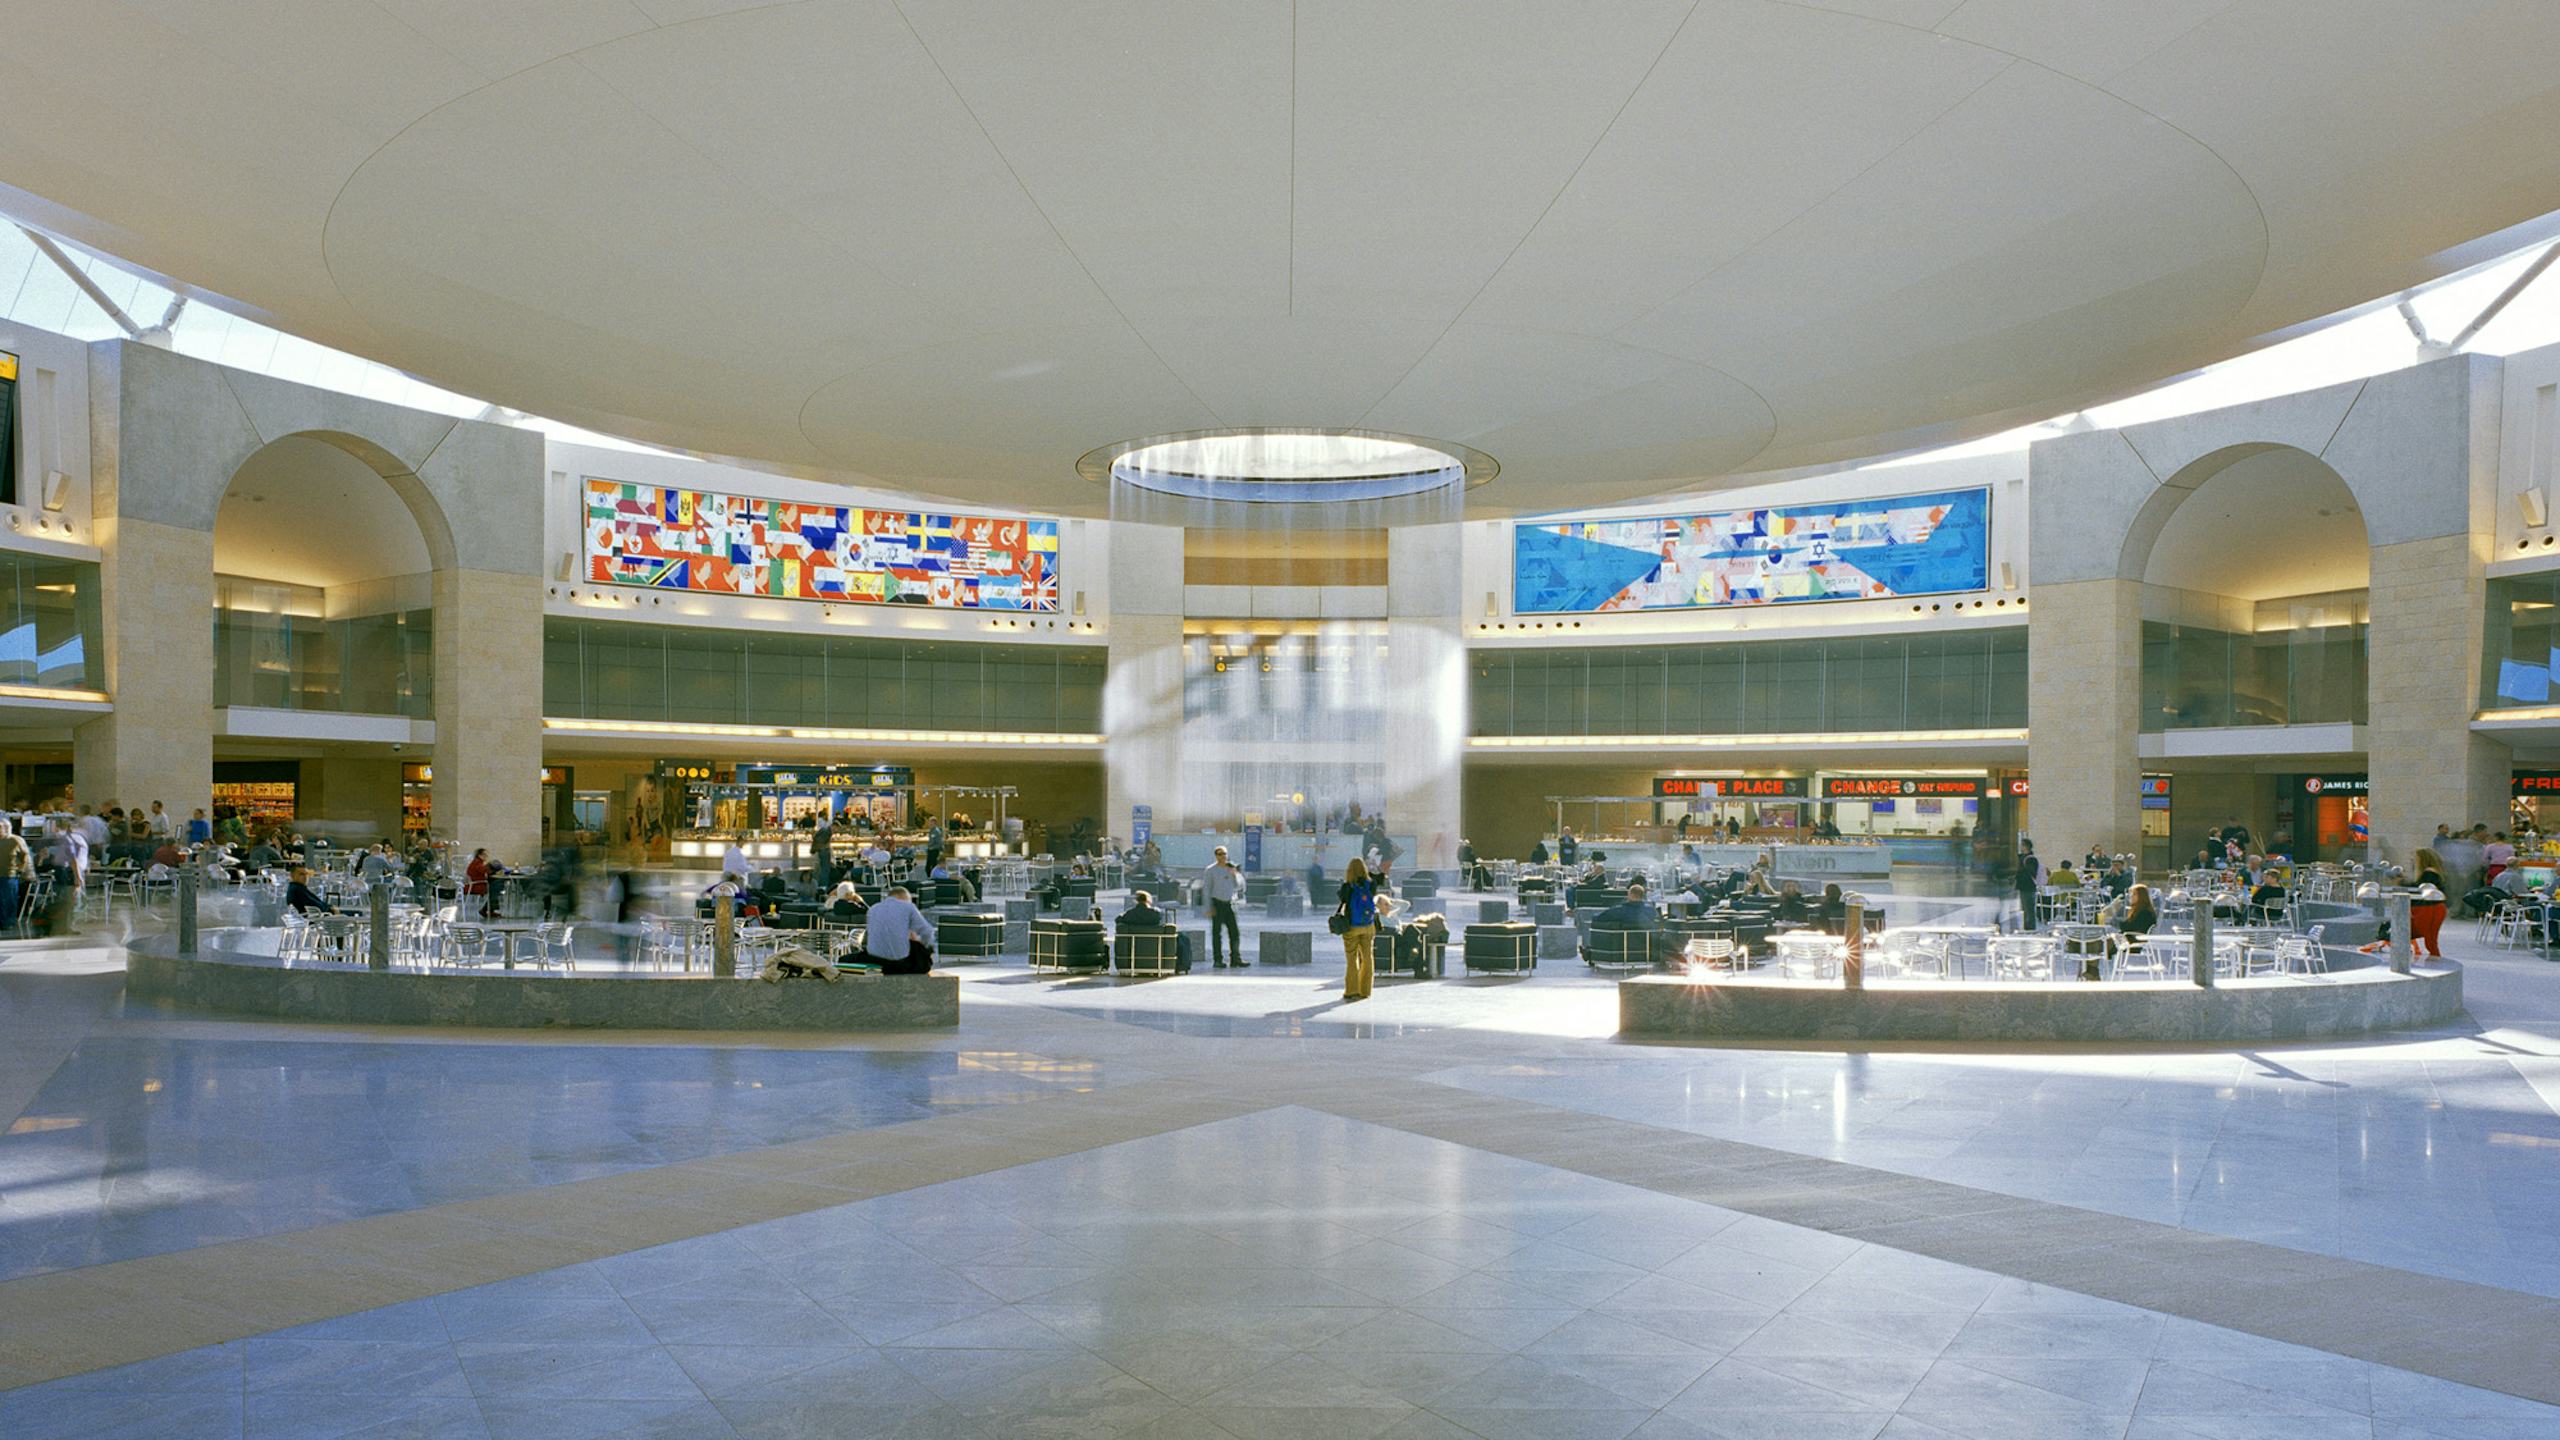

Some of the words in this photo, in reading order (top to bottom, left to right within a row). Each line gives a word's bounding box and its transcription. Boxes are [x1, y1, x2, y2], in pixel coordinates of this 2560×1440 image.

[1663, 780, 1727, 794] CHAE
[1733, 781, 1785, 794] PLACE
[1830, 780, 1901, 794] CHANGE
[2323, 782, 2352, 790] JAMES
